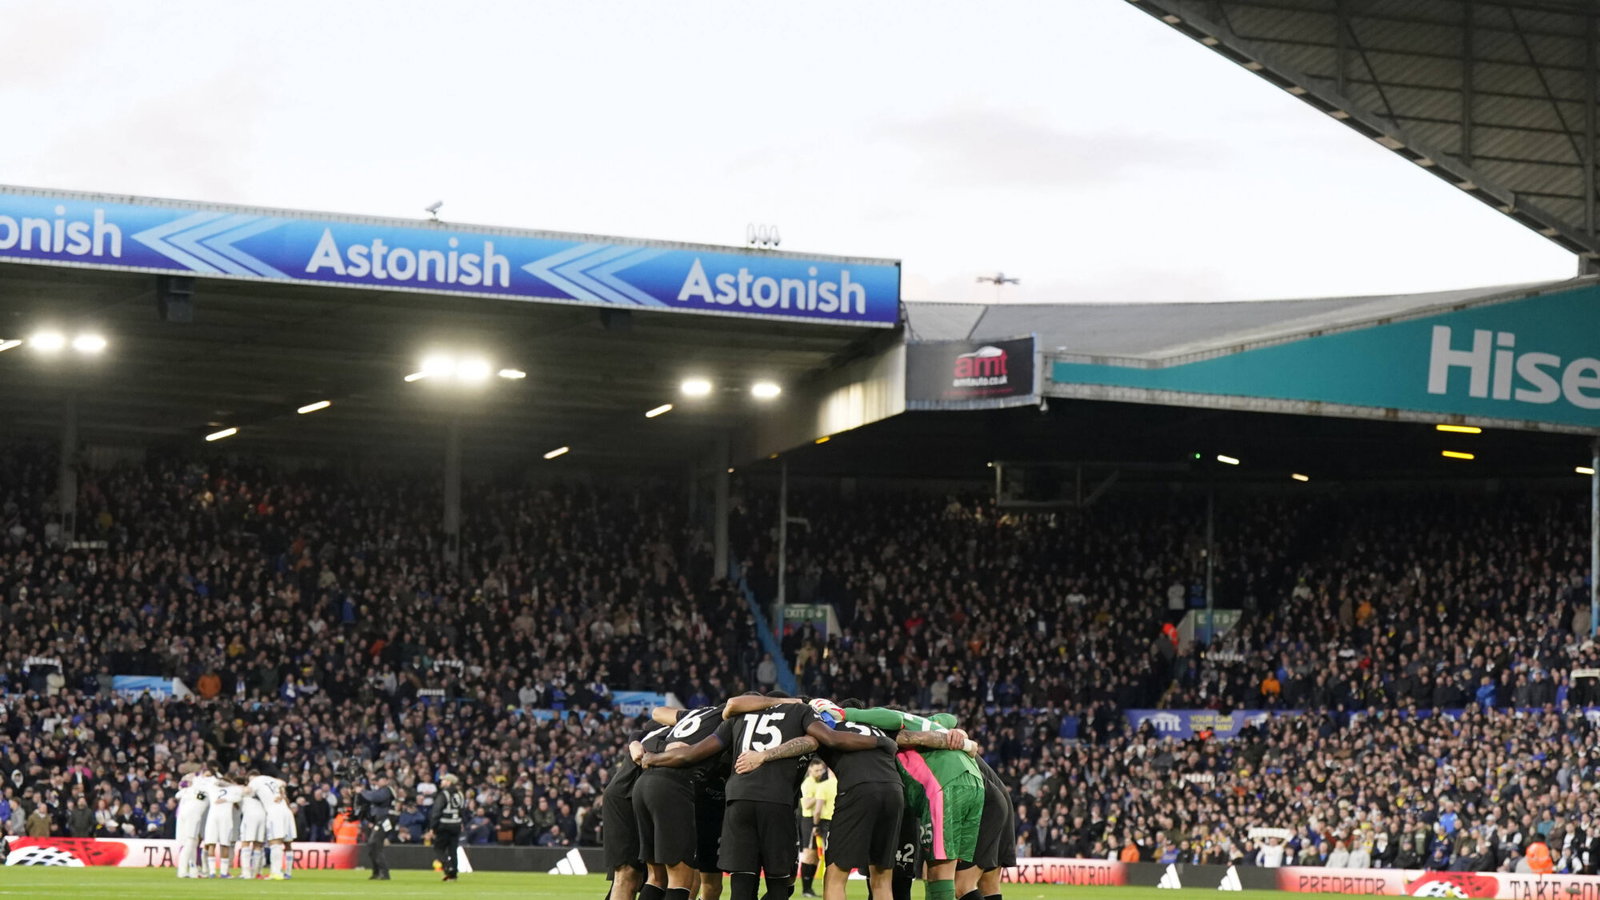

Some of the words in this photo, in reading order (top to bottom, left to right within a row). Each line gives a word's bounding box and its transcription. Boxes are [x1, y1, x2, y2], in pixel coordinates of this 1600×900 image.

[305, 227, 510, 288] Astonish
[677, 257, 866, 314] Astonish
[953, 350, 1008, 378] amt
[1427, 325, 1600, 409] Hise
[741, 712, 785, 752] 15
[1001, 864, 1044, 883] AKE
[1299, 875, 1386, 895] PREDATOR
